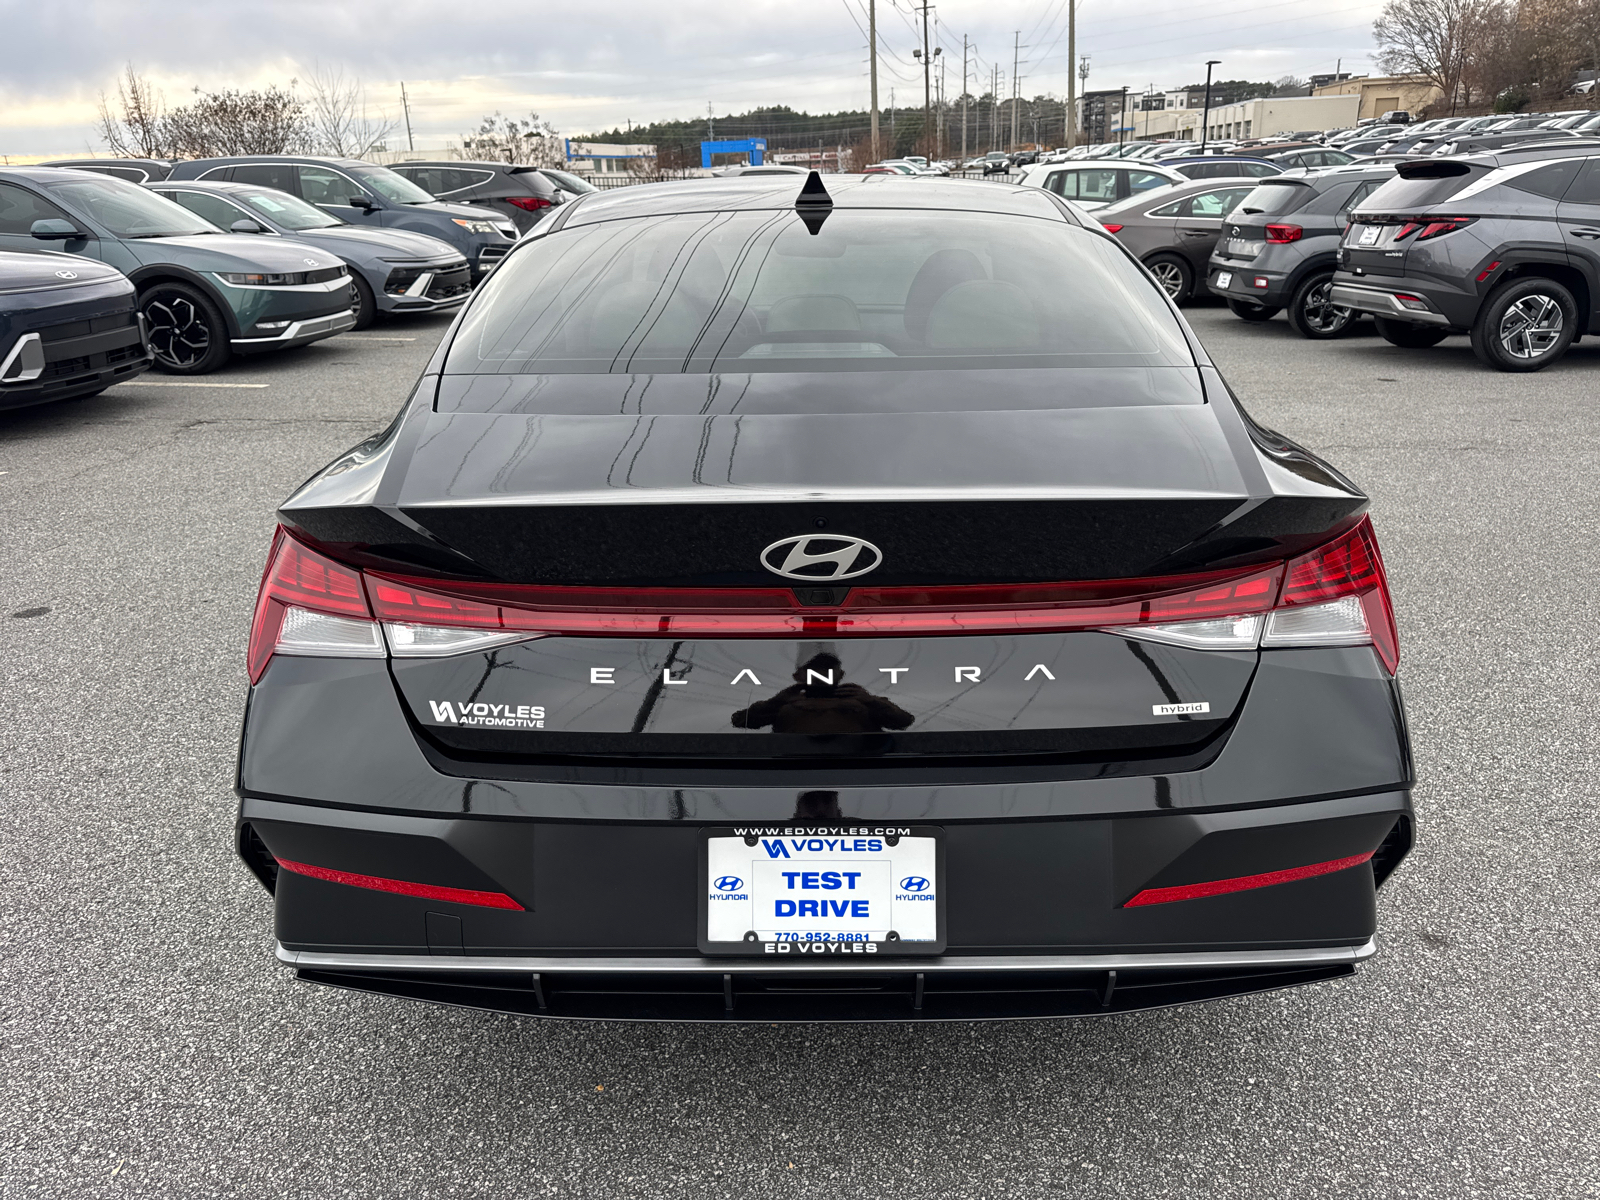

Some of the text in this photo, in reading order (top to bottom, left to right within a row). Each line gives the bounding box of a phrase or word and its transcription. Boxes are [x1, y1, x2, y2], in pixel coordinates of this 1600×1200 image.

[590, 663, 1056, 687] ELANTRA
[458, 702, 545, 719] VOYLES
[1161, 704, 1202, 713] hybrid
[459, 716, 545, 728] AUTOMOTIVE
[734, 828, 911, 836] WWW.EDVOYLES.COM
[791, 839, 883, 851] VOYLES
[782, 872, 861, 889] TEST
[775, 900, 870, 917] DRIVE
[775, 932, 870, 942] 770-952-8881
[764, 943, 878, 953] ED VOYLES
